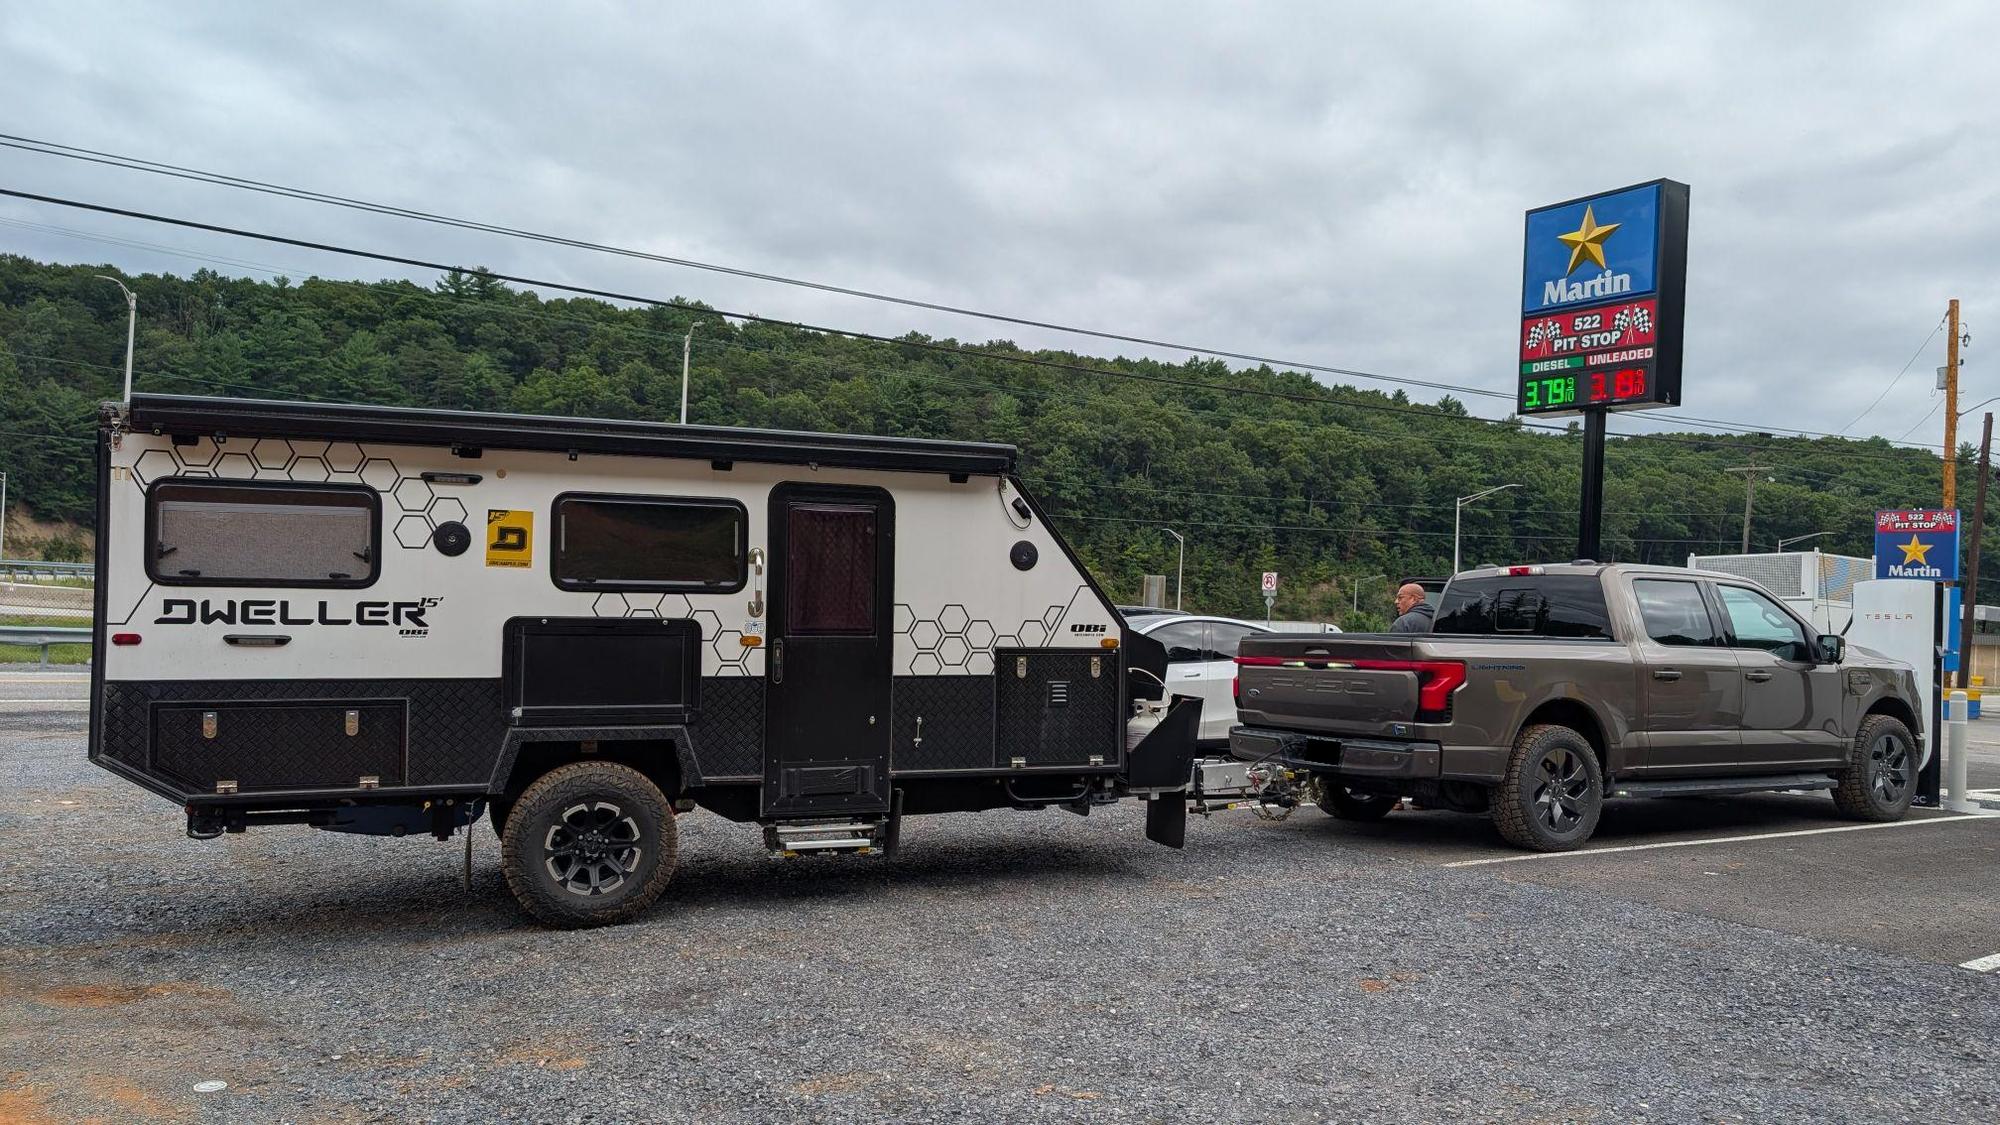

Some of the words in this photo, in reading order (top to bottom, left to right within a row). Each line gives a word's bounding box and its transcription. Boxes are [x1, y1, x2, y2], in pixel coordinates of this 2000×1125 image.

[1542, 270, 1630, 305] Martin
[1574, 315, 1600, 330] 522
[1554, 337, 1577, 351] PIT
[1581, 331, 1620, 347] STOP
[1589, 348, 1653, 365] UNLEADED
[1532, 359, 1571, 373] DIESEL
[1888, 565, 1941, 577] Martin
[154, 598, 430, 628] DWELLER
